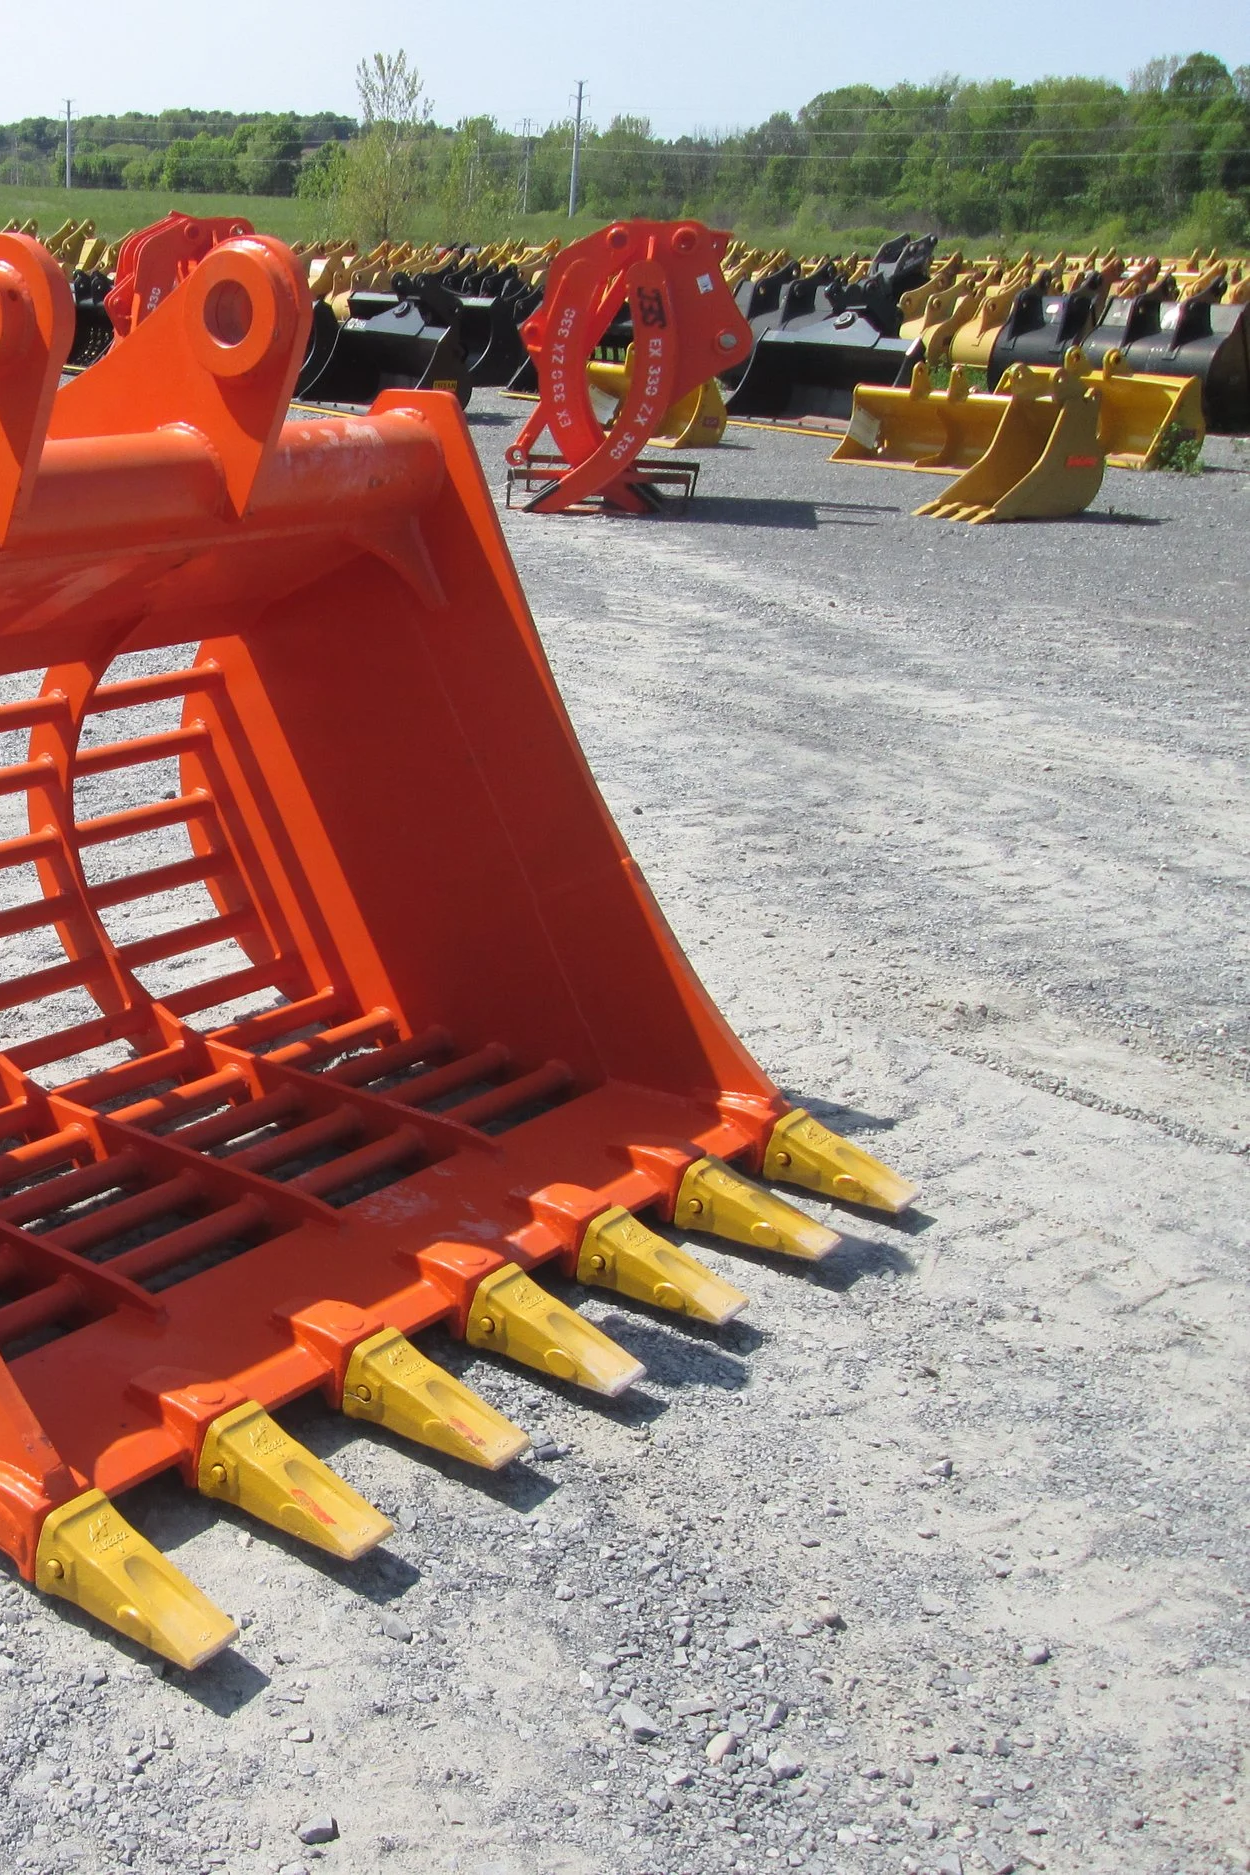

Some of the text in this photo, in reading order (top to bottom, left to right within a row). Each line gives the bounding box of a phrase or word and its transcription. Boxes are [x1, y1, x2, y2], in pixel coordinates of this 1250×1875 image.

[551, 307, 577, 428] EX 330 ZX 330
[609, 338, 662, 461] EX 330 ZX 330
